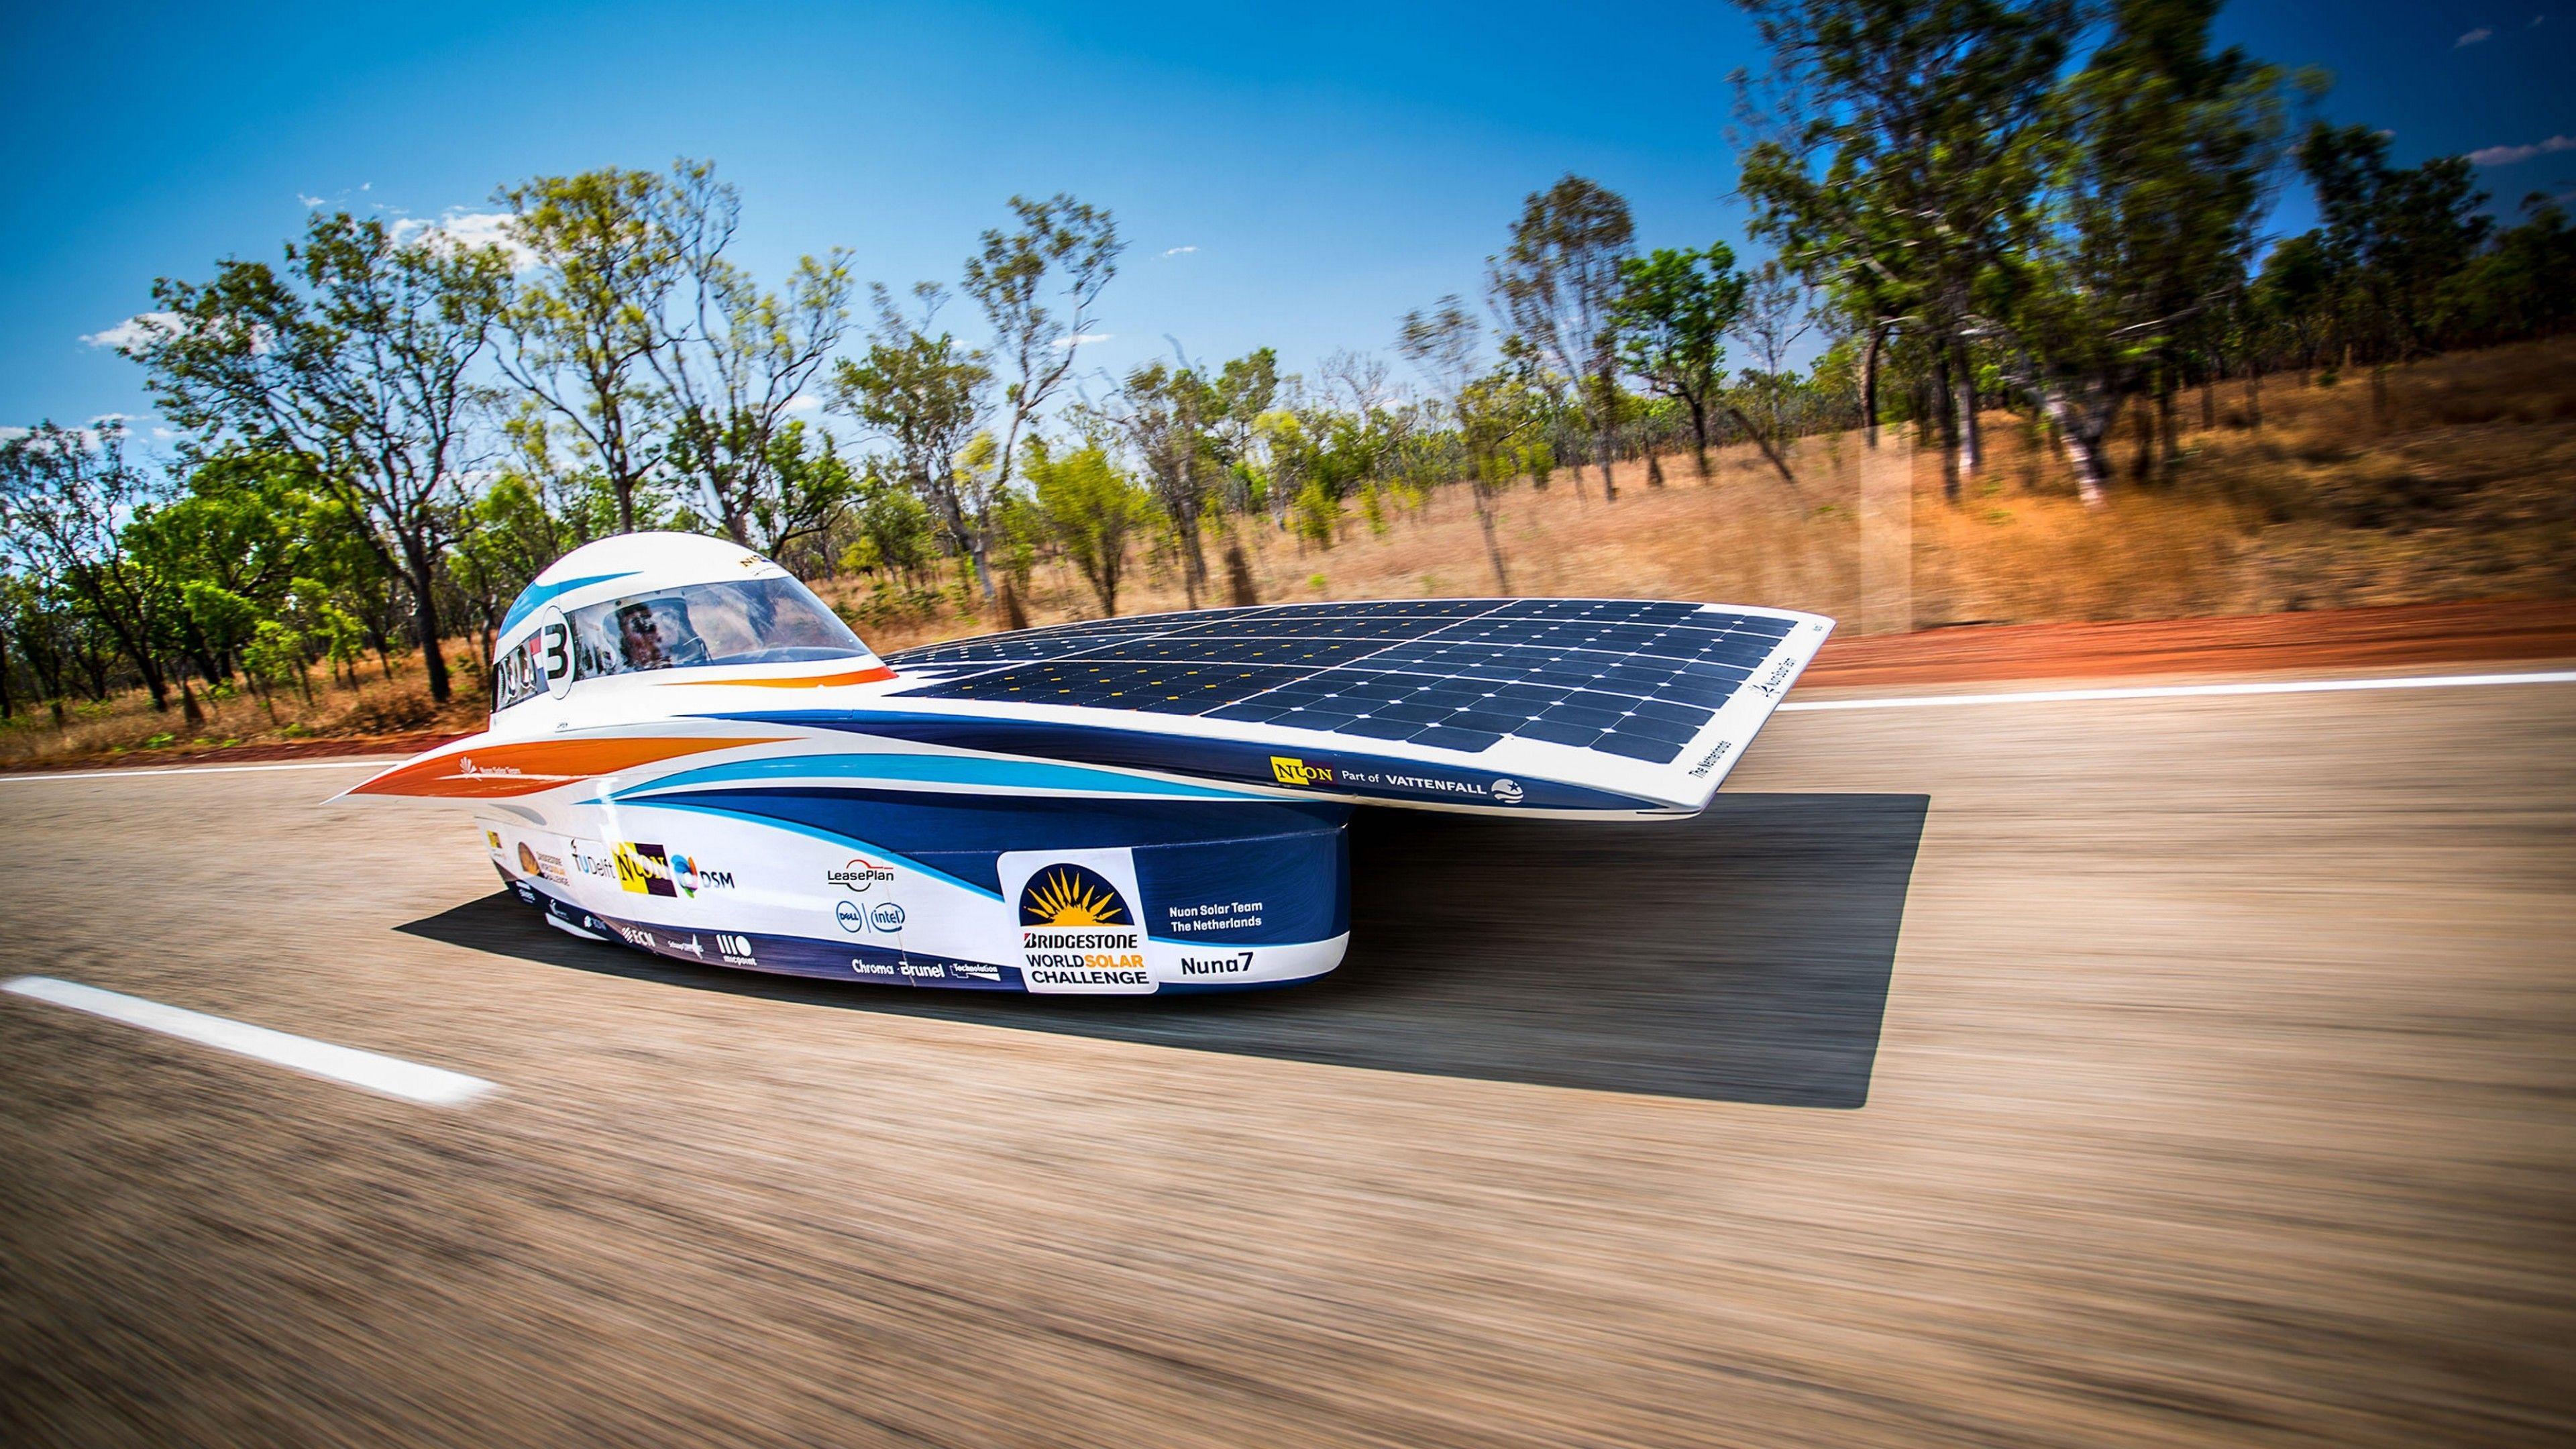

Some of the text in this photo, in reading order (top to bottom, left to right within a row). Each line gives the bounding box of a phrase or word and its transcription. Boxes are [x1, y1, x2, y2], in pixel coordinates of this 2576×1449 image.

[545, 623, 569, 680] 3
[1688, 741, 1731, 778] The Netherlands
[1275, 763, 1487, 795] NUON Part of VATTENFALL
[700, 871, 735, 889] DSM
[828, 870, 894, 881] LeasePlan
[839, 910, 900, 924] DELL intel
[1169, 902, 1263, 918] Nuon Solar Team
[1171, 915, 1263, 932] The Netherlands
[1023, 932, 1138, 949] BRIDGESTONE
[851, 958, 895, 975] Chroma
[898, 961, 945, 977] Brunel
[953, 963, 998, 973] Technolution
[1181, 951, 1254, 975] Nuna7
[1031, 970, 1150, 984] CHALLENGE
